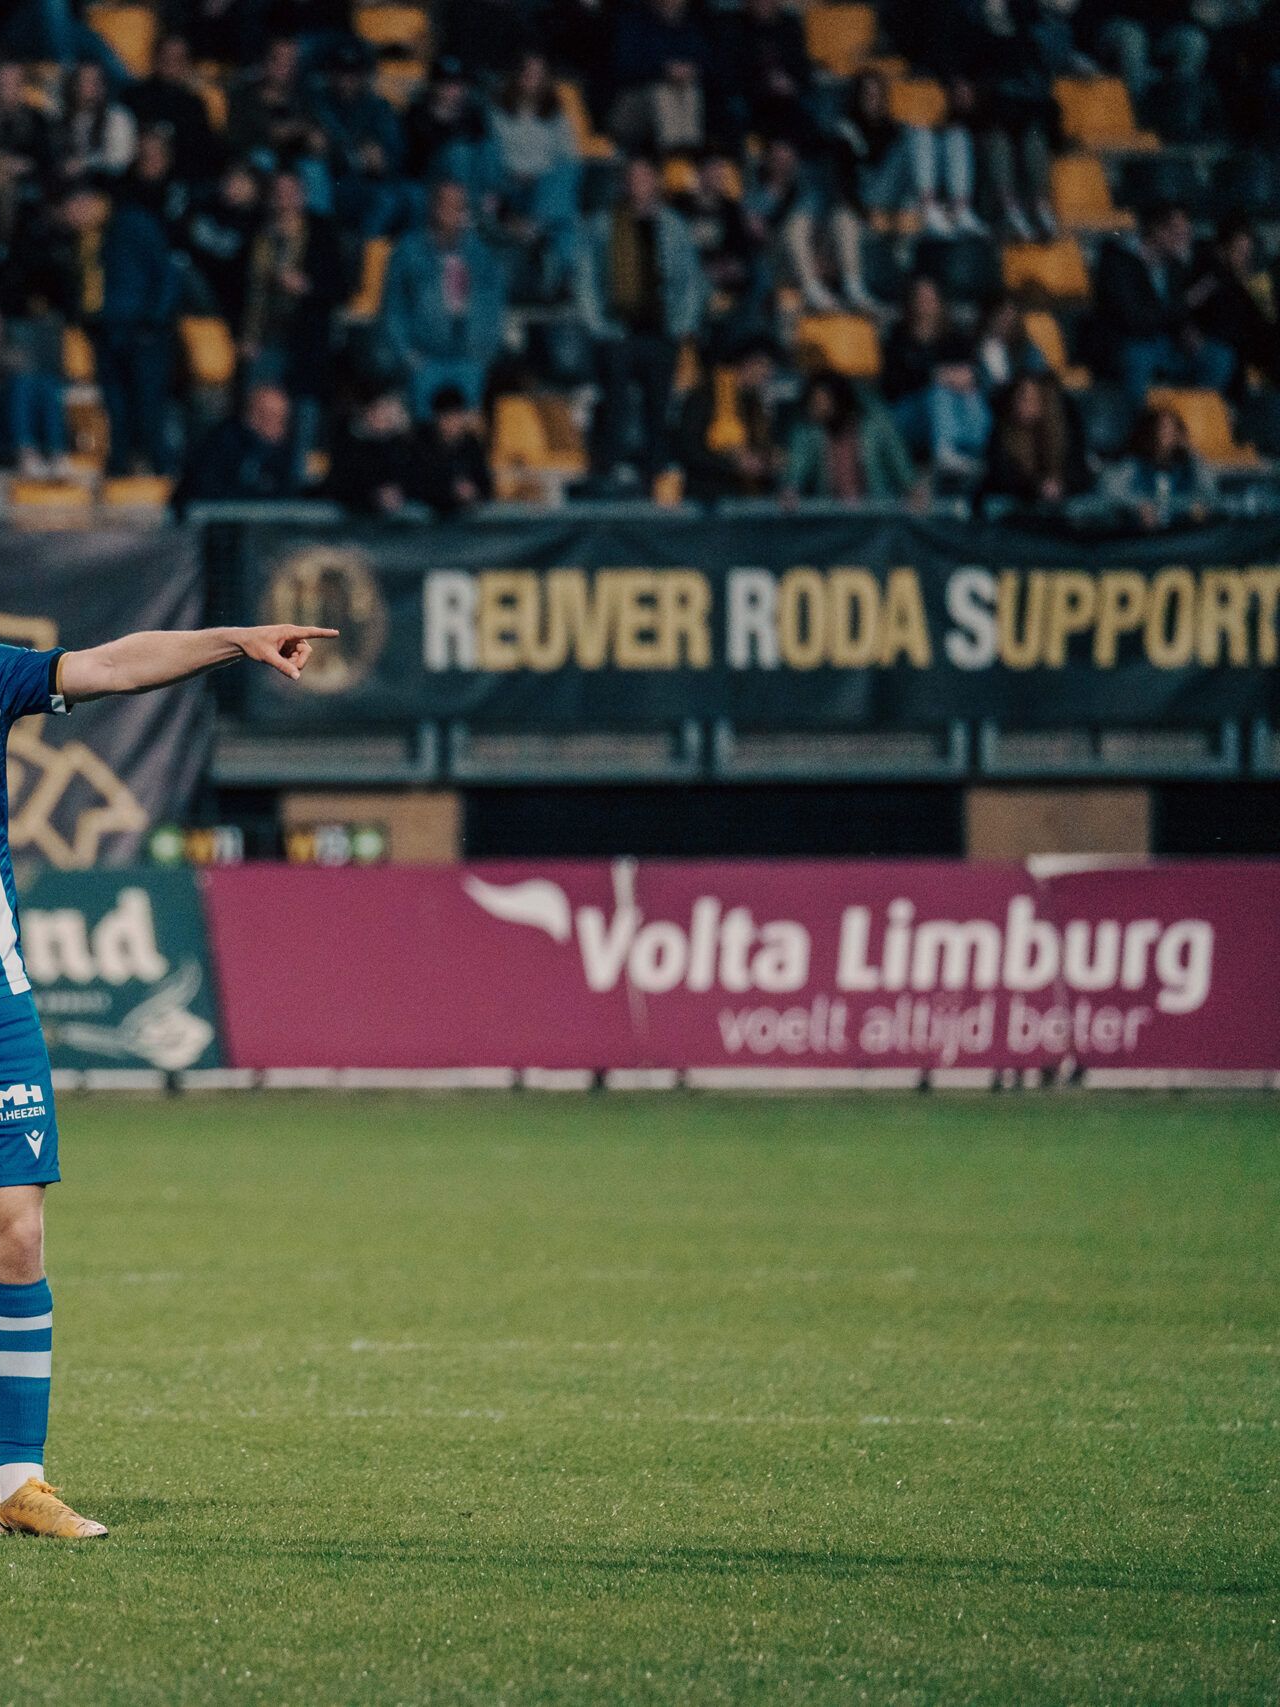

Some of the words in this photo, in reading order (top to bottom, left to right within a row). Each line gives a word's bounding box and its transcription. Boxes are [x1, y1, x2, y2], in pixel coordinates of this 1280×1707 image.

[423, 567, 712, 672] REUVER
[725, 566, 932, 671] RODA
[944, 565, 1280, 672] SUPPORT
[576, 896, 812, 993] Volta
[836, 894, 1216, 1014] Limburg
[719, 994, 848, 1035] voelt
